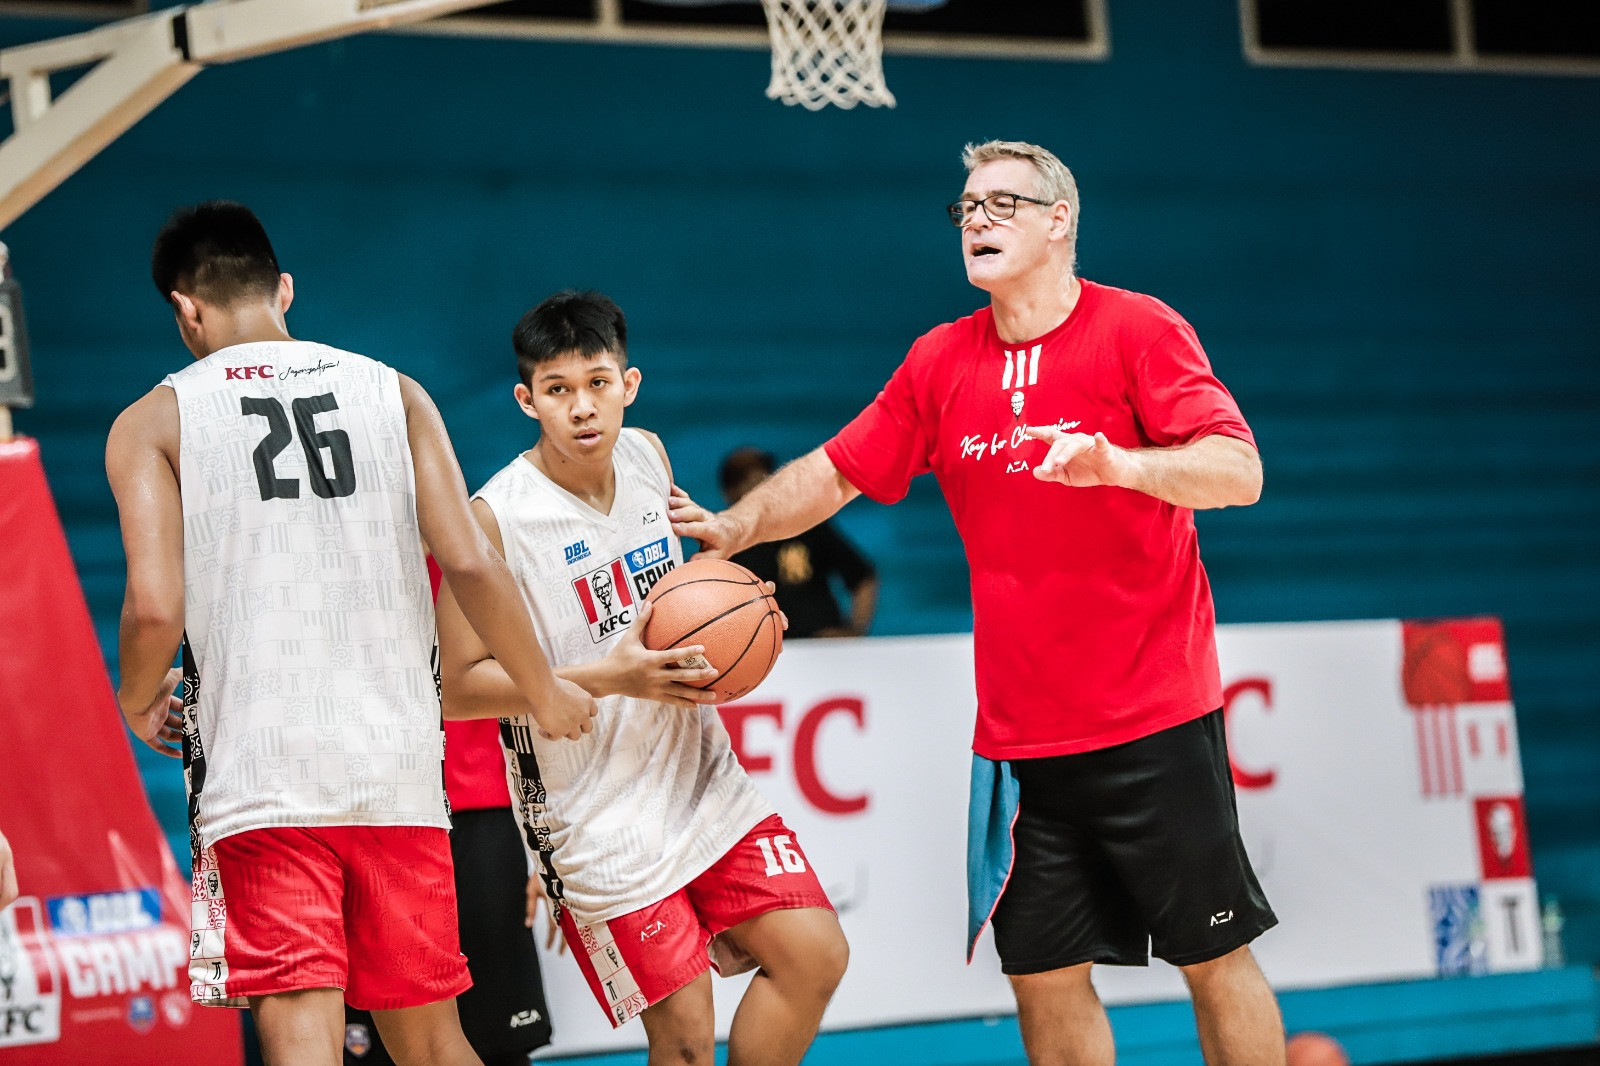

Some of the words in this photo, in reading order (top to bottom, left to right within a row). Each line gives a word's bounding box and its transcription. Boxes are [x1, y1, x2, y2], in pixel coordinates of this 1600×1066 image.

[225, 365, 274, 380] KFC
[240, 392, 356, 501] 26
[564, 540, 589, 560] DBL
[643, 542, 666, 565] DBL
[598, 610, 631, 637] KFC
[716, 696, 869, 816] FC
[756, 835, 806, 877] 16
[63, 929, 187, 998] CAMP
[0, 1004, 43, 1034] FC
